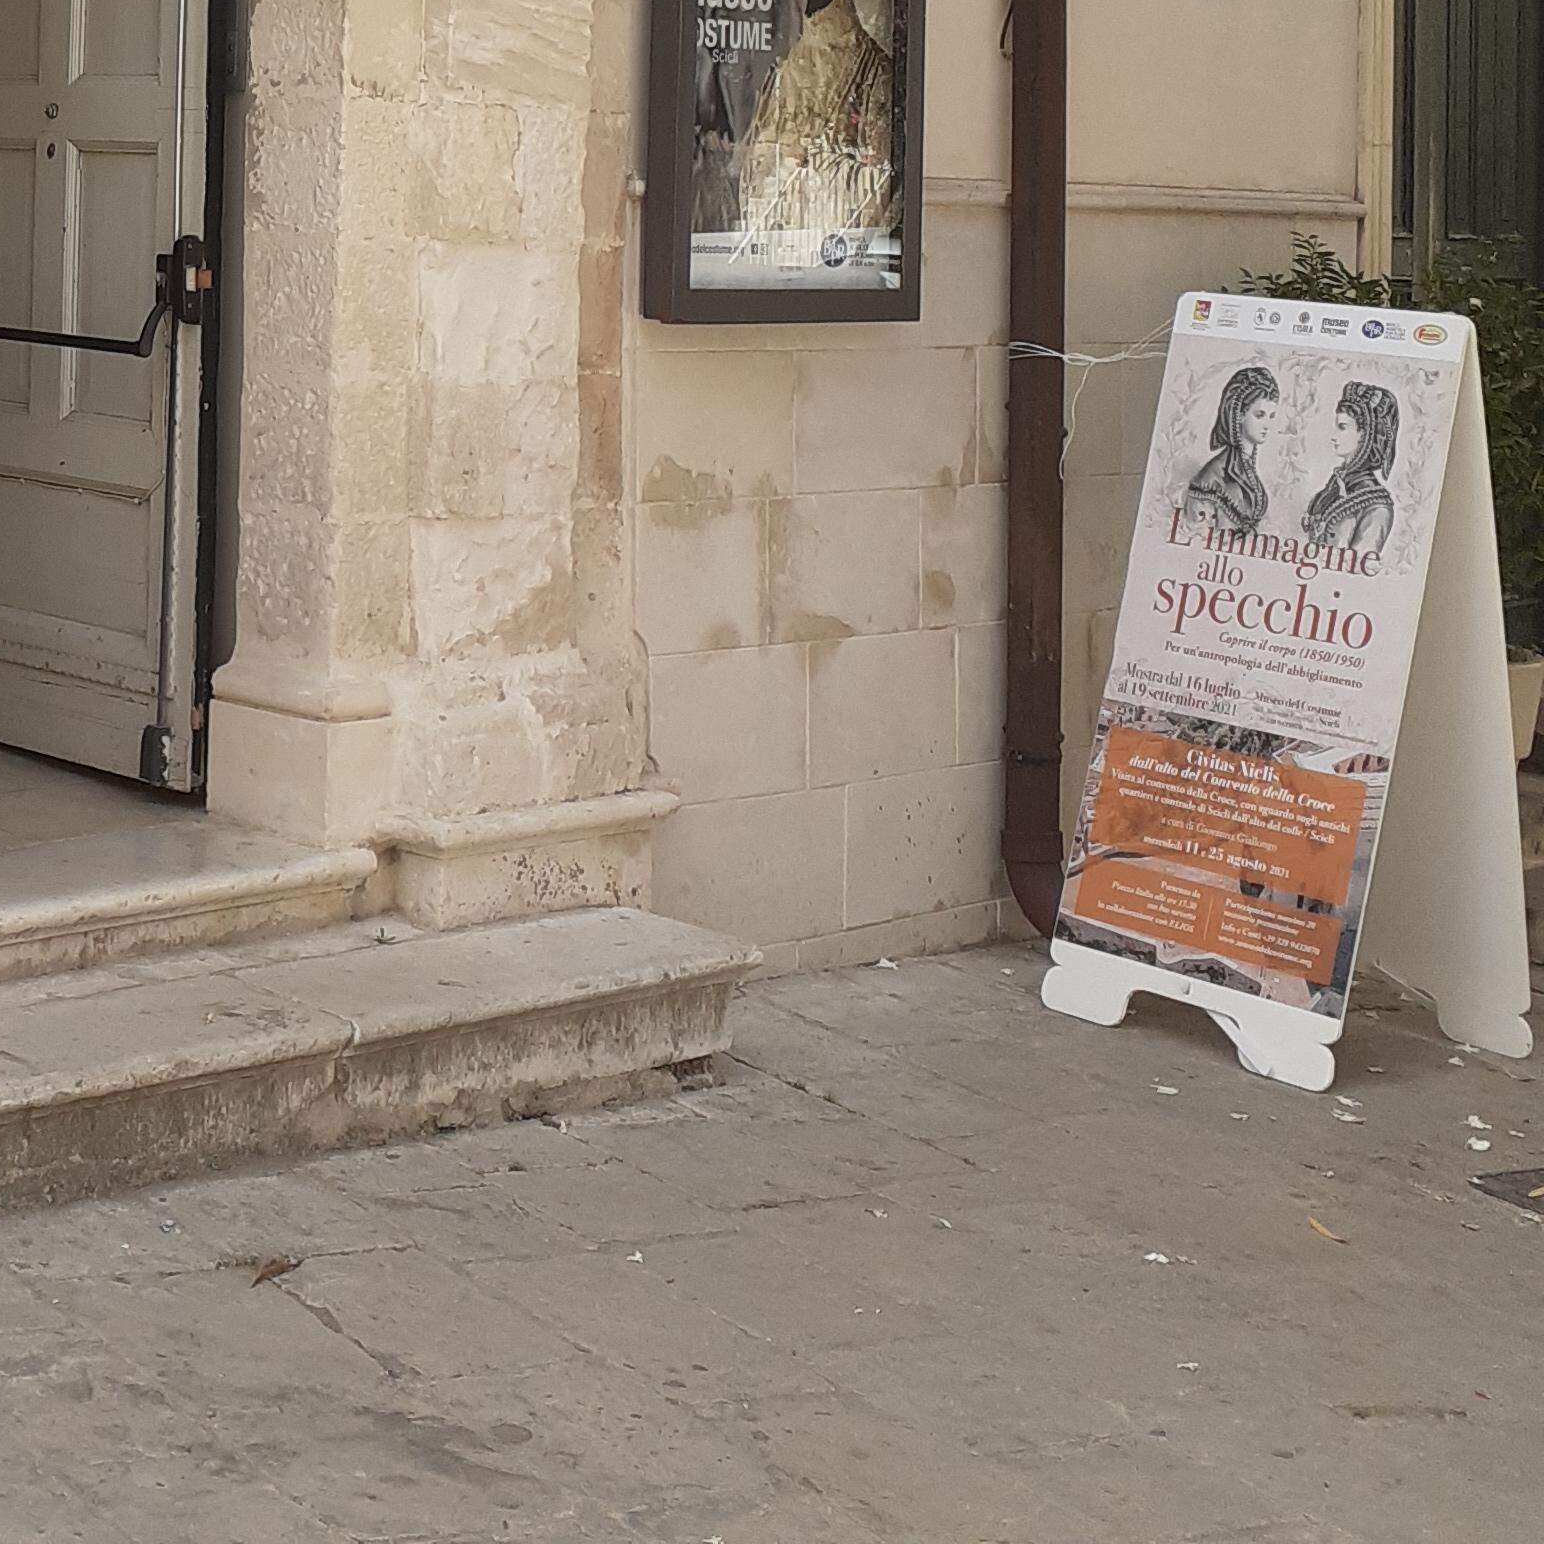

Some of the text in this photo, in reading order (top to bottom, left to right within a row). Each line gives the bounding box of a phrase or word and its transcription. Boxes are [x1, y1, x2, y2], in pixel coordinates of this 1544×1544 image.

[1166, 507, 1381, 580] L'immagine
[1197, 554, 1243, 586] allo
[1153, 578, 1374, 650] specchio
[1165, 640, 1363, 688] Per un'antropologia dell'abbigliamento
[1219, 631, 1365, 670] Coprire il corpo (1850/1950)
[1117, 680, 1128, 693] al
[1132, 682, 1147, 696] 19
[1149, 689, 1209, 710] settembre
[1210, 701, 1237, 716] 2021
[1127, 662, 1241, 699] Mostra dal 16 luglio
[1187, 749, 1235, 773] Civitas
[1129, 755, 1179, 776] dall'alto
[1181, 767, 1201, 781] del
[1262, 785, 1295, 803] della
[1297, 793, 1336, 812] Croce
[1186, 840, 1200, 855] 11
[1207, 846, 1225, 861] 25
[1226, 854, 1267, 873] agosto
